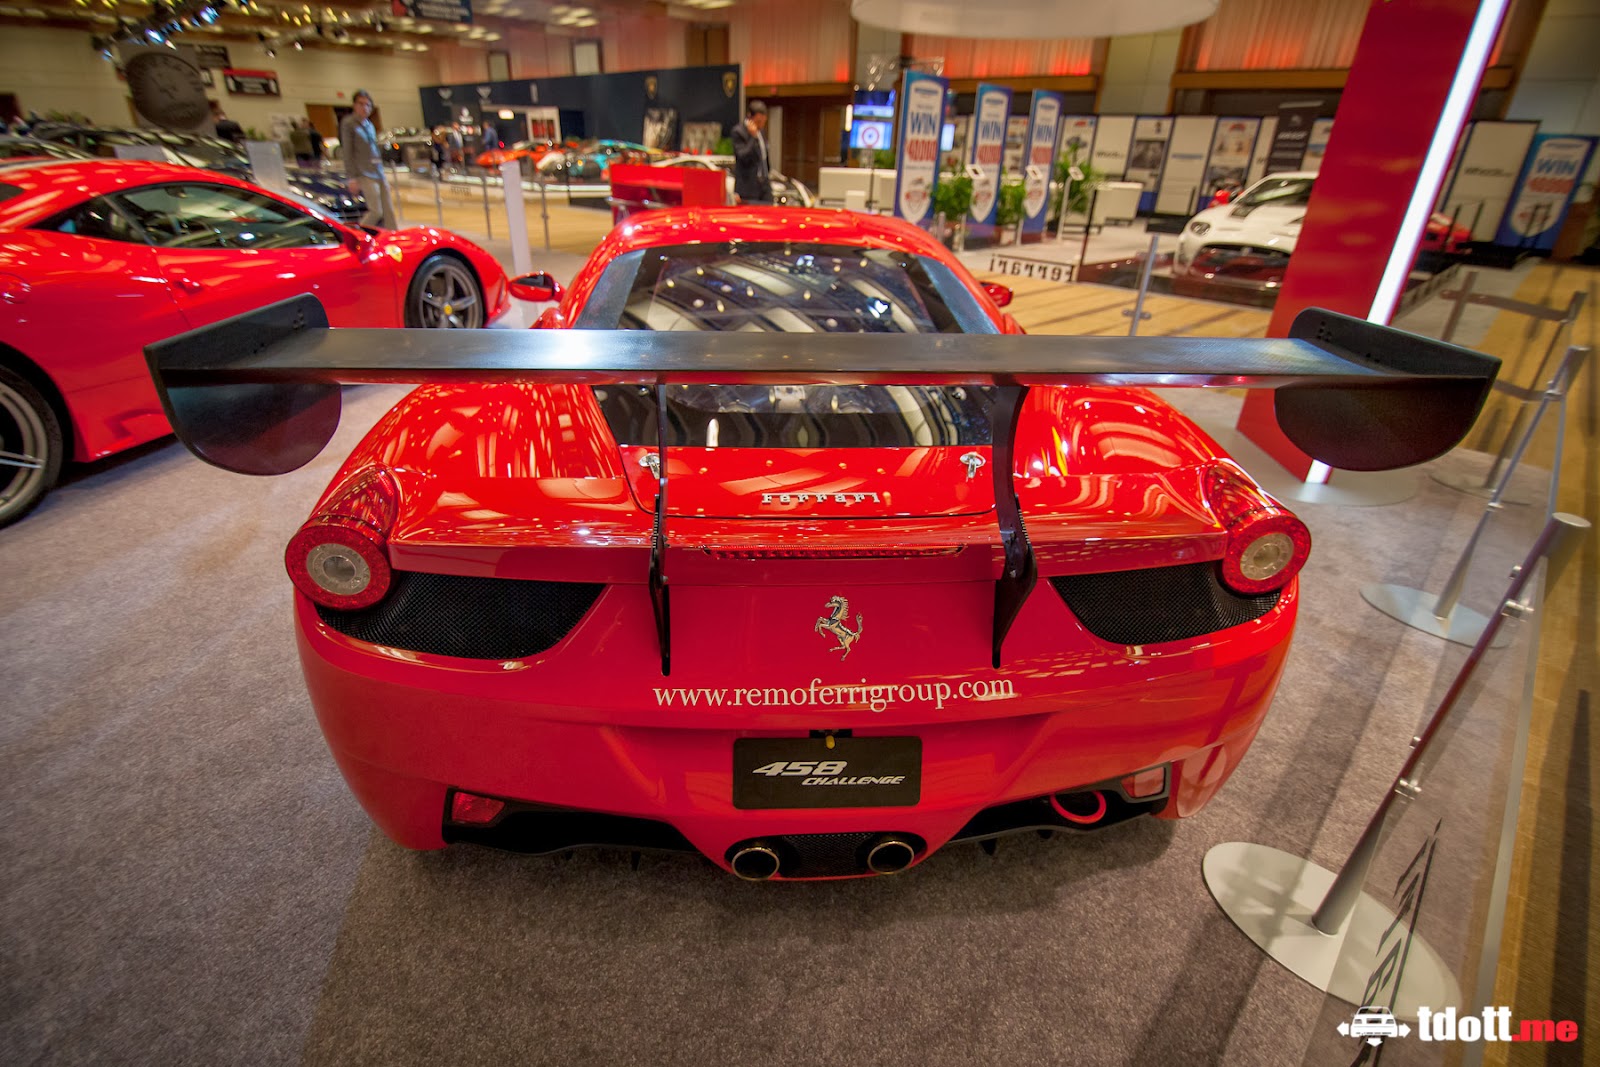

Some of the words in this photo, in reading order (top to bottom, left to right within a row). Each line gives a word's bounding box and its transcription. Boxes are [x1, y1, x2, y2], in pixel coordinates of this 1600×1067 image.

[910, 112, 938, 136] WIN
[1536, 158, 1579, 175] WIN
[761, 491, 881, 504] Ferrari
[653, 678, 1015, 712] www.remoferrigroup.com
[752, 760, 847, 776] 458
[801, 774, 906, 786] CHALLENGE
